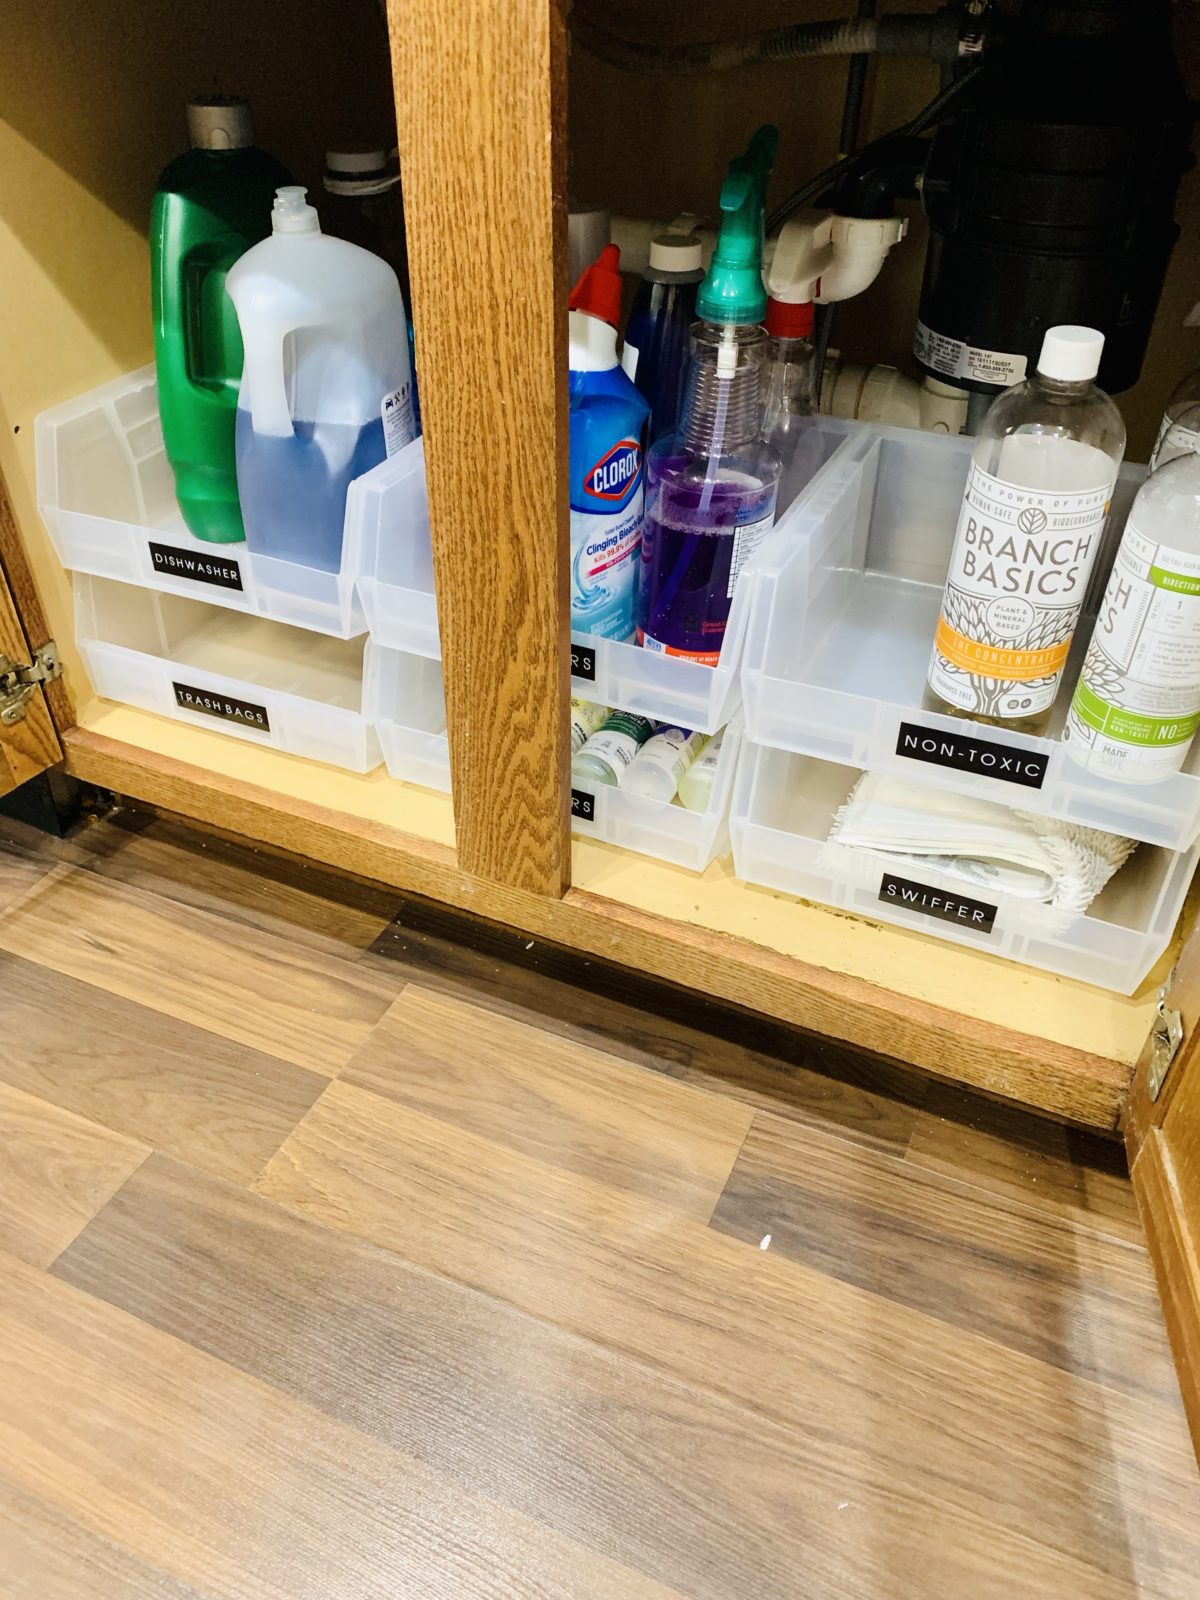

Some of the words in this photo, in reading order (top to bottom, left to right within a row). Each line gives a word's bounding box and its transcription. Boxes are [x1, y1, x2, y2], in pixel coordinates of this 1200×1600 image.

[593, 447, 638, 493] CLOROX
[977, 478, 992, 492] THE
[999, 490, 1044, 506] POWER
[1053, 500, 1069, 508] OF
[1077, 495, 1104, 506] PURE
[972, 494, 1012, 520] HUMAN-SAFE
[1052, 511, 1101, 527] BIODEGRADABLE
[586, 536, 618, 556] Clinging
[618, 521, 637, 540] Bleach
[606, 545, 624, 558] 99.9%
[965, 516, 1092, 566] BRANCH
[154, 552, 239, 581] DISHWASHER
[963, 549, 1079, 595] BASICS
[994, 613, 1026, 624] MINERAL
[996, 605, 1020, 615] PLANT
[996, 622, 1021, 631] BASED
[952, 637, 969, 654] THE
[975, 648, 1056, 666] CONCENTRATE
[178, 690, 221, 711] TRASH
[225, 703, 264, 723] BAGS
[959, 690, 972, 701] FREE
[1157, 725, 1178, 740] NO
[904, 734, 1041, 778] NON-TOXIC
[886, 883, 985, 924] SWIFFER
